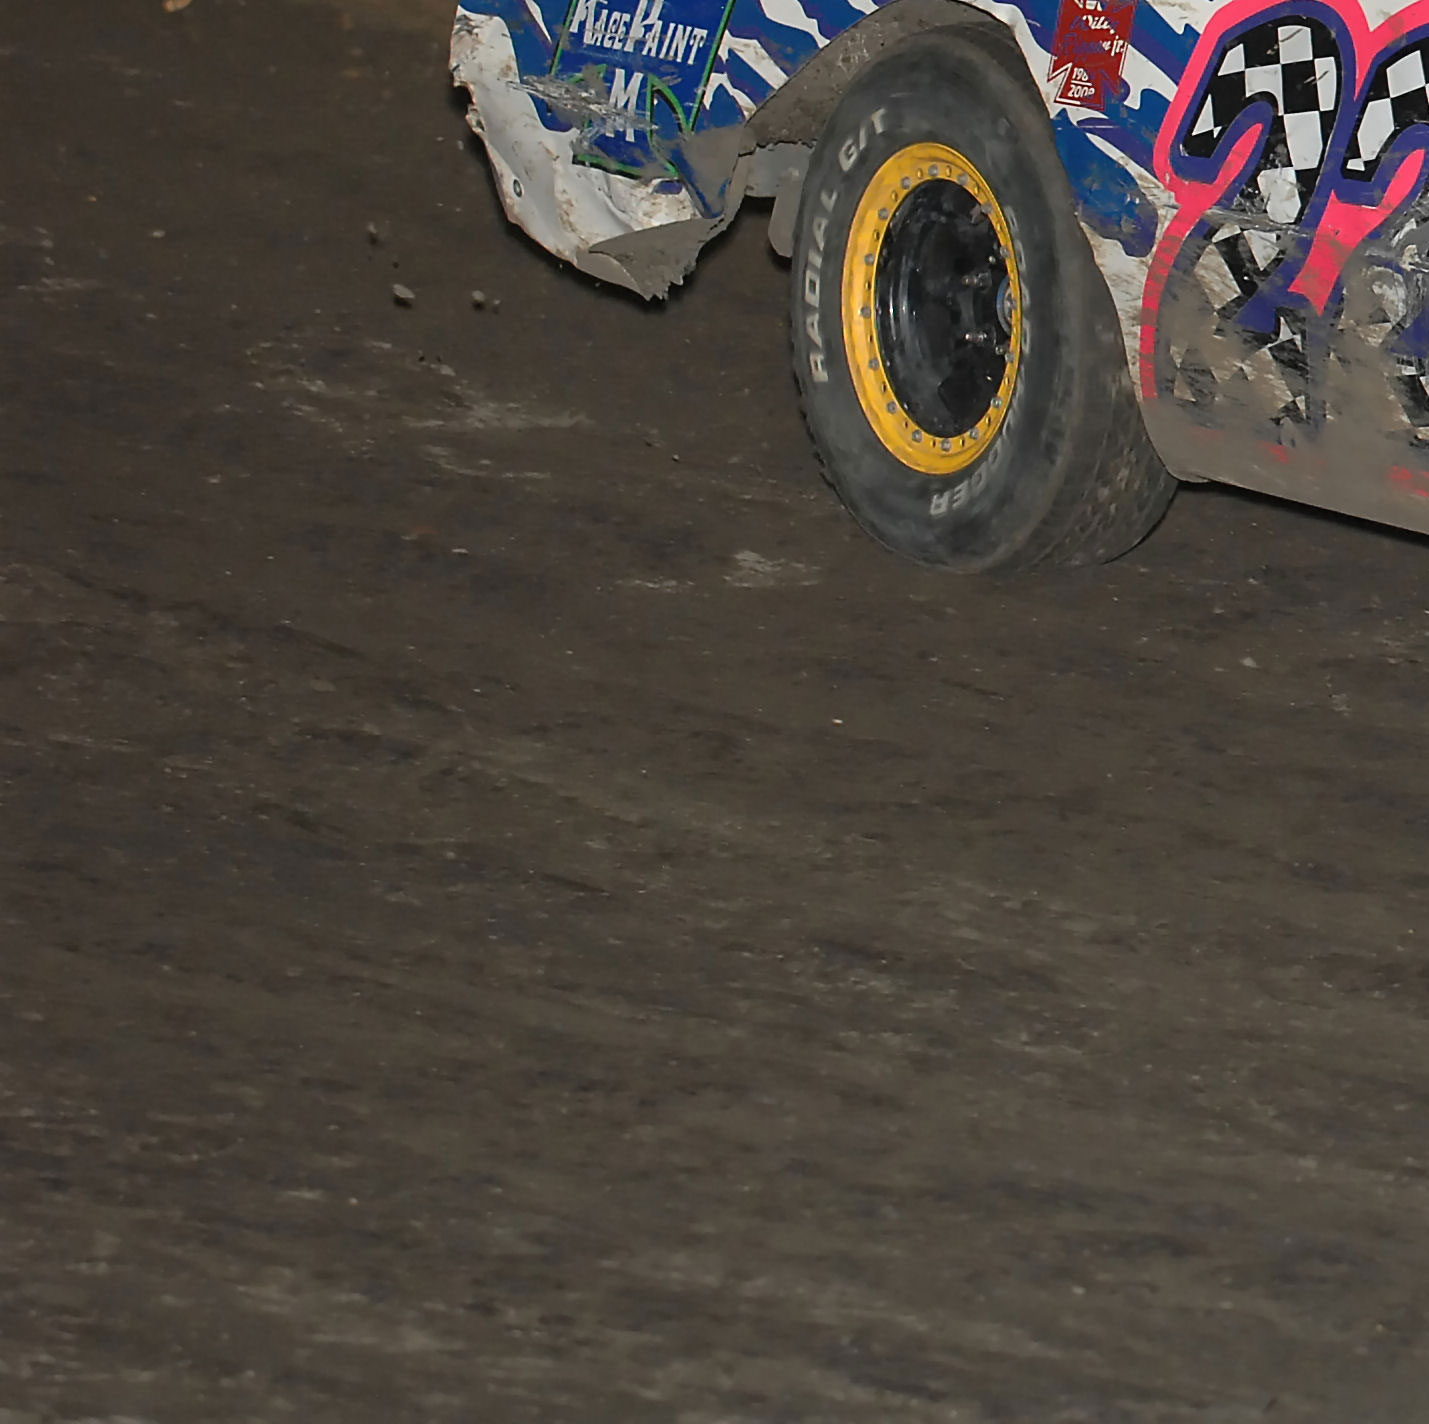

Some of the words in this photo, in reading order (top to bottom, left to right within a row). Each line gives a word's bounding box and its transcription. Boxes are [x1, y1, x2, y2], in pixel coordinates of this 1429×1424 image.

[604, 68, 644, 143] M
[802, 188, 839, 384] RADIAL
[837, 106, 889, 173] G/T
